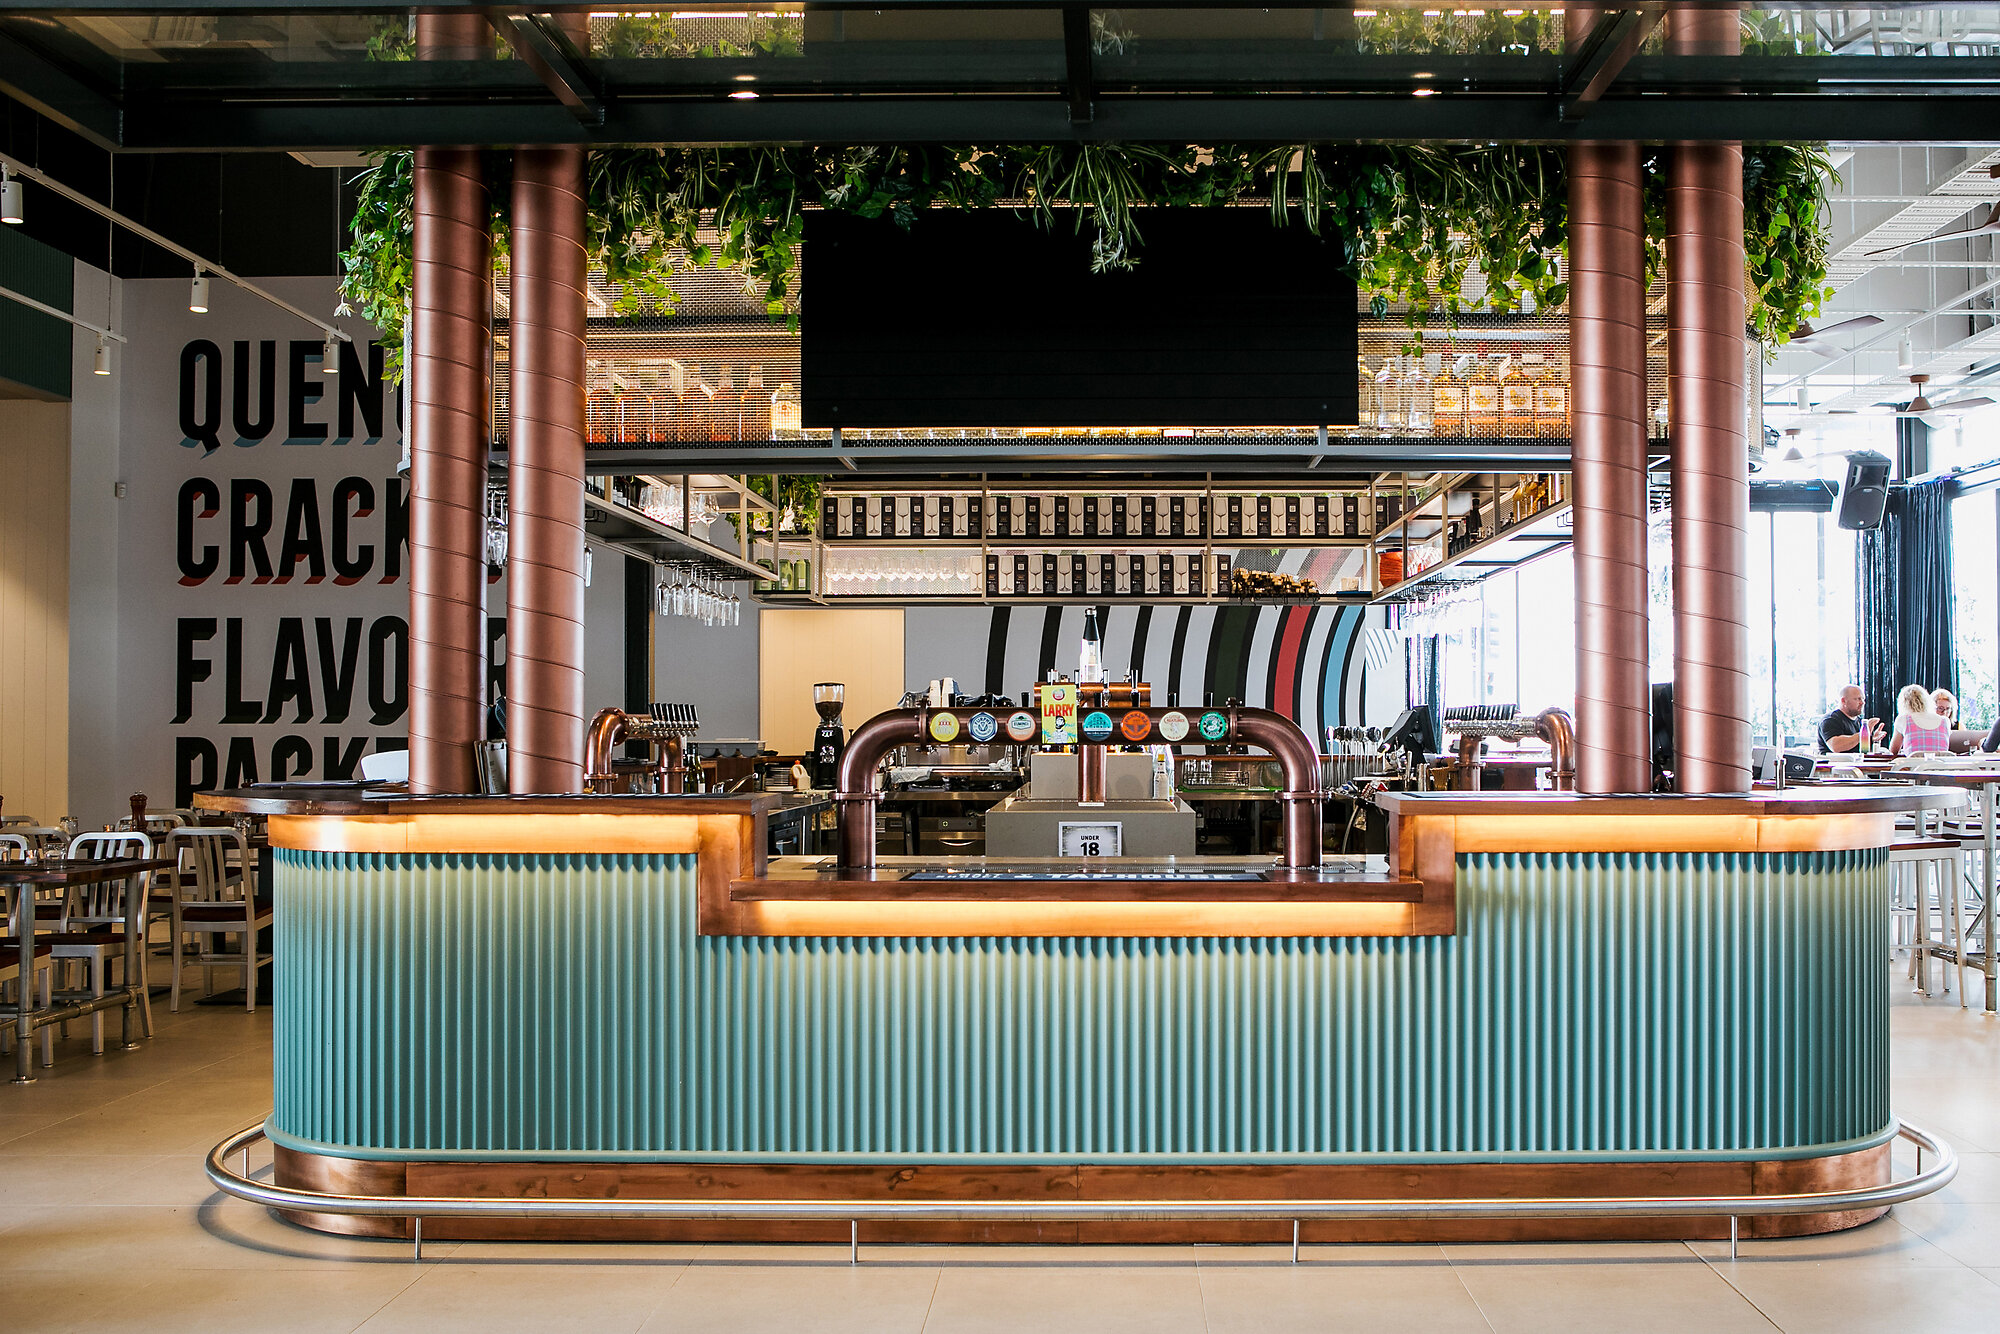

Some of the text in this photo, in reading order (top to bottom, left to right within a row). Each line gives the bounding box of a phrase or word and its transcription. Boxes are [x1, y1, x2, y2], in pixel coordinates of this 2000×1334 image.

[179, 339, 404, 452] QUEN
[177, 477, 502, 579] CRACK
[172, 616, 507, 722] FLAVOR
[1043, 703, 1075, 717] LARRY
[1080, 842, 1100, 857] 18
